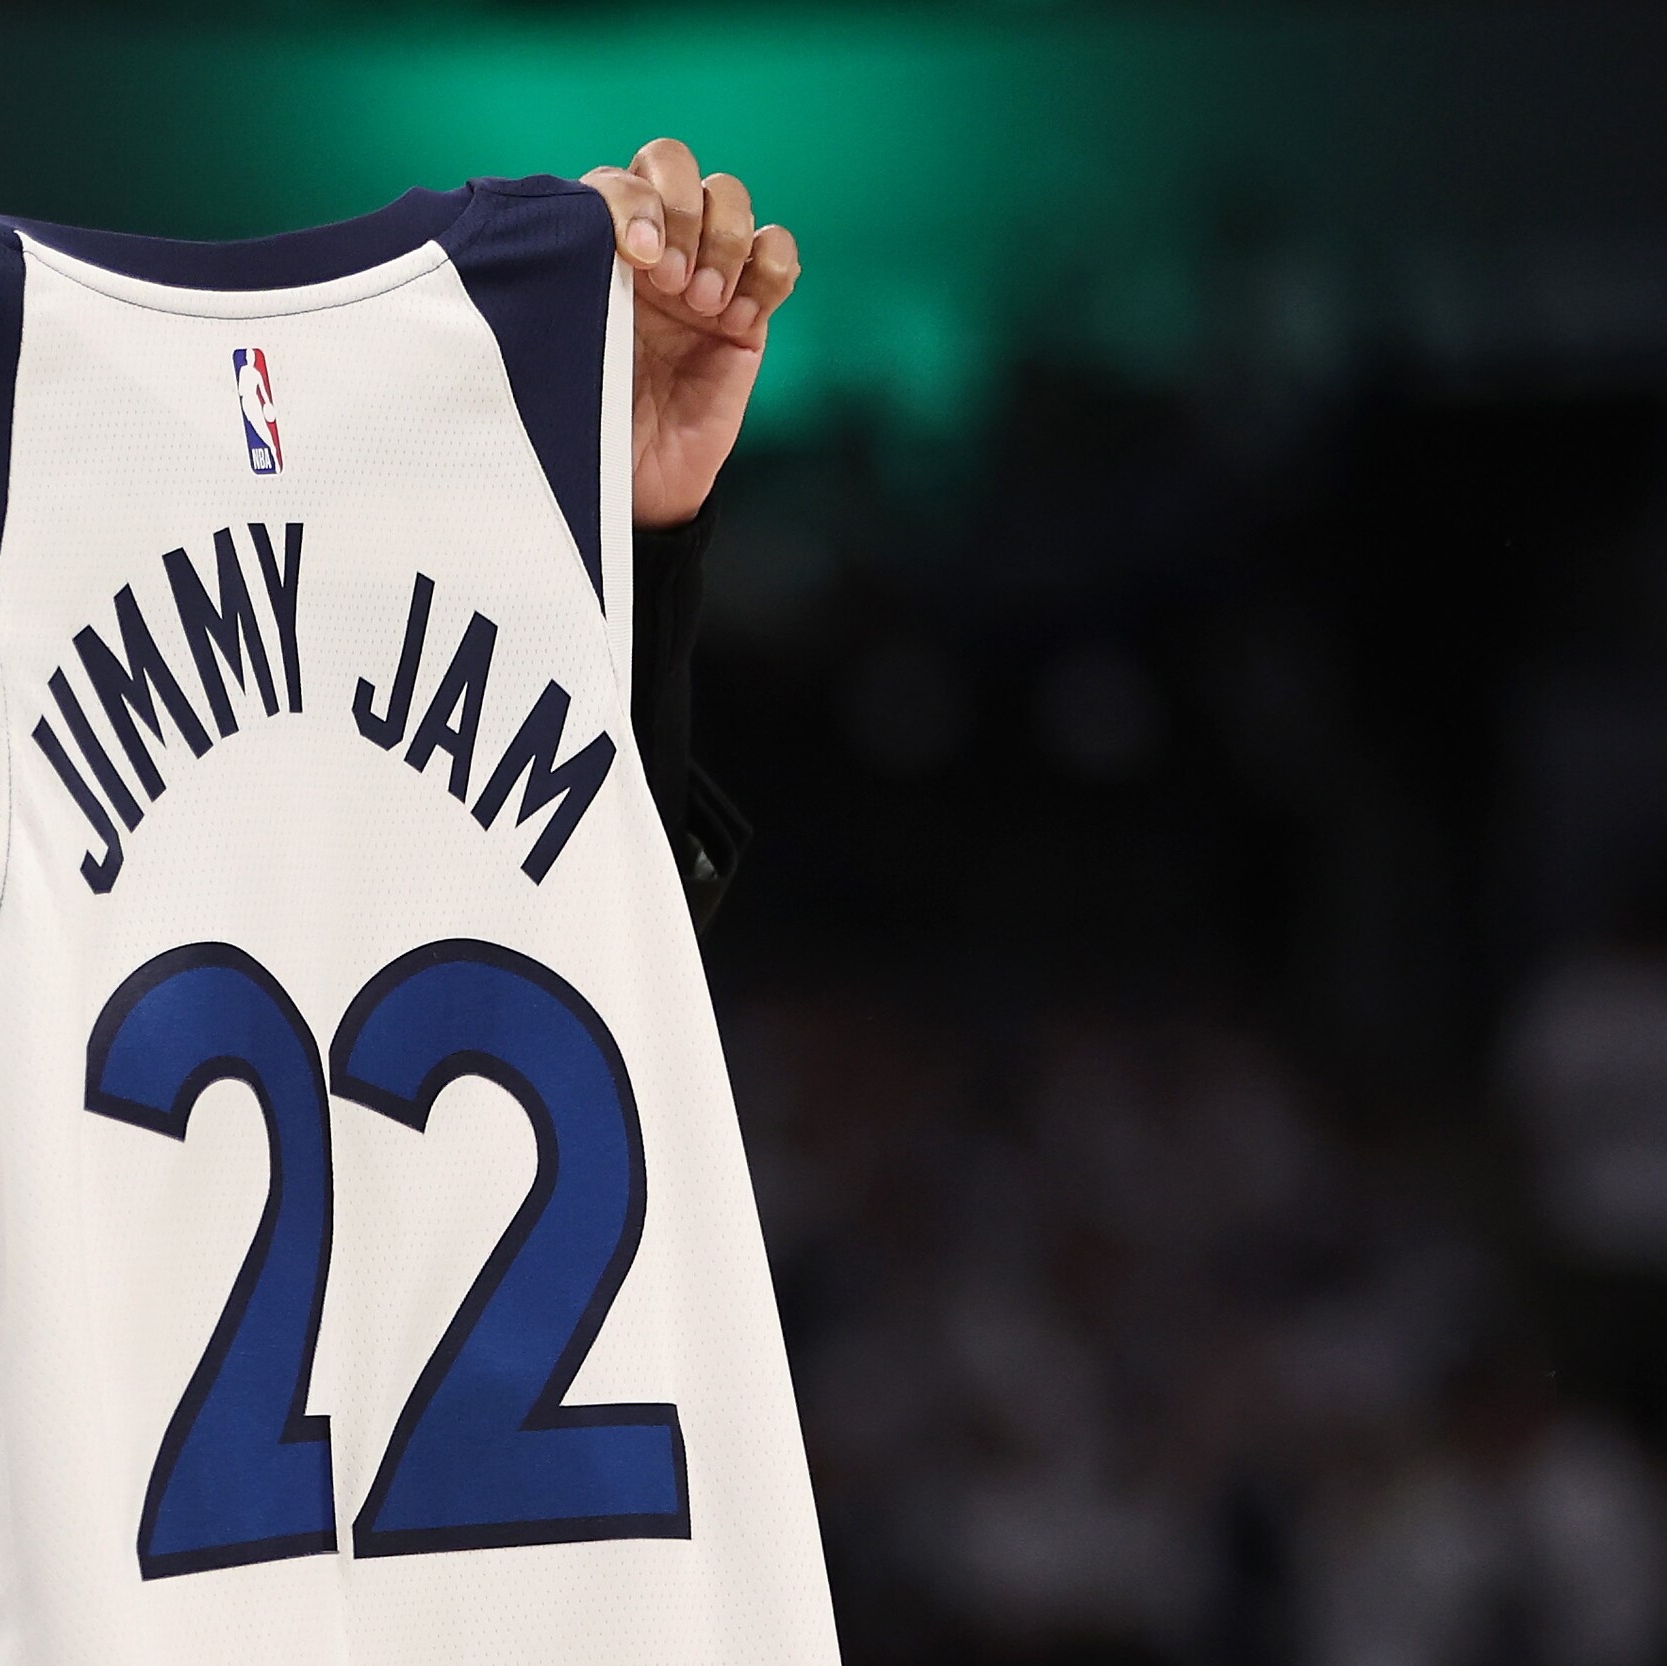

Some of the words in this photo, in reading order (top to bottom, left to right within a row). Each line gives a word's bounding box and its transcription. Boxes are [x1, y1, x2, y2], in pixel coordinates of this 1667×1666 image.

[251, 447, 273, 470] NBA
[31, 522, 304, 895] JIMMY
[351, 571, 617, 887] JAM
[83, 937, 692, 1582] 22
